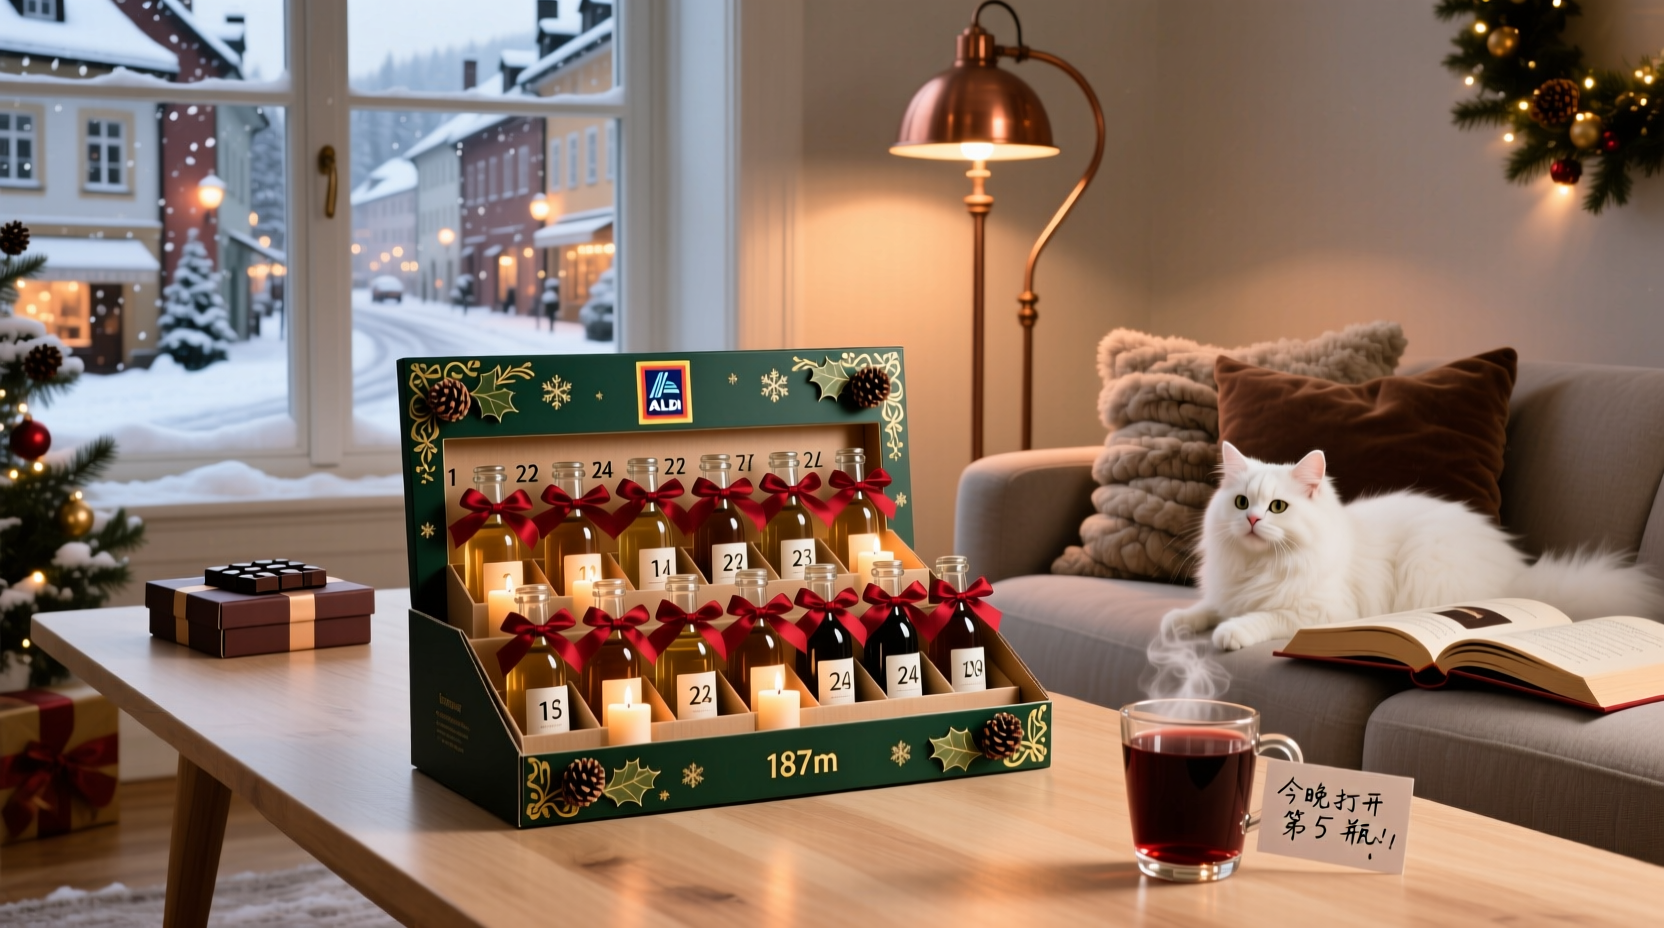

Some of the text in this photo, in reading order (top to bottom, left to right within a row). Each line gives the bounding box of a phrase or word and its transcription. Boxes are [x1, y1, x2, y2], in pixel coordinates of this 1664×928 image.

[649, 398, 682, 412] ALDI
[516, 464, 539, 483] 22
[592, 461, 614, 479] 24
[664, 457, 686, 475] 22
[792, 549, 813, 567] 23
[897, 665, 919, 685] 24
[766, 748, 838, 779] 187m
[1277, 776, 1384, 817] 今晚打开
